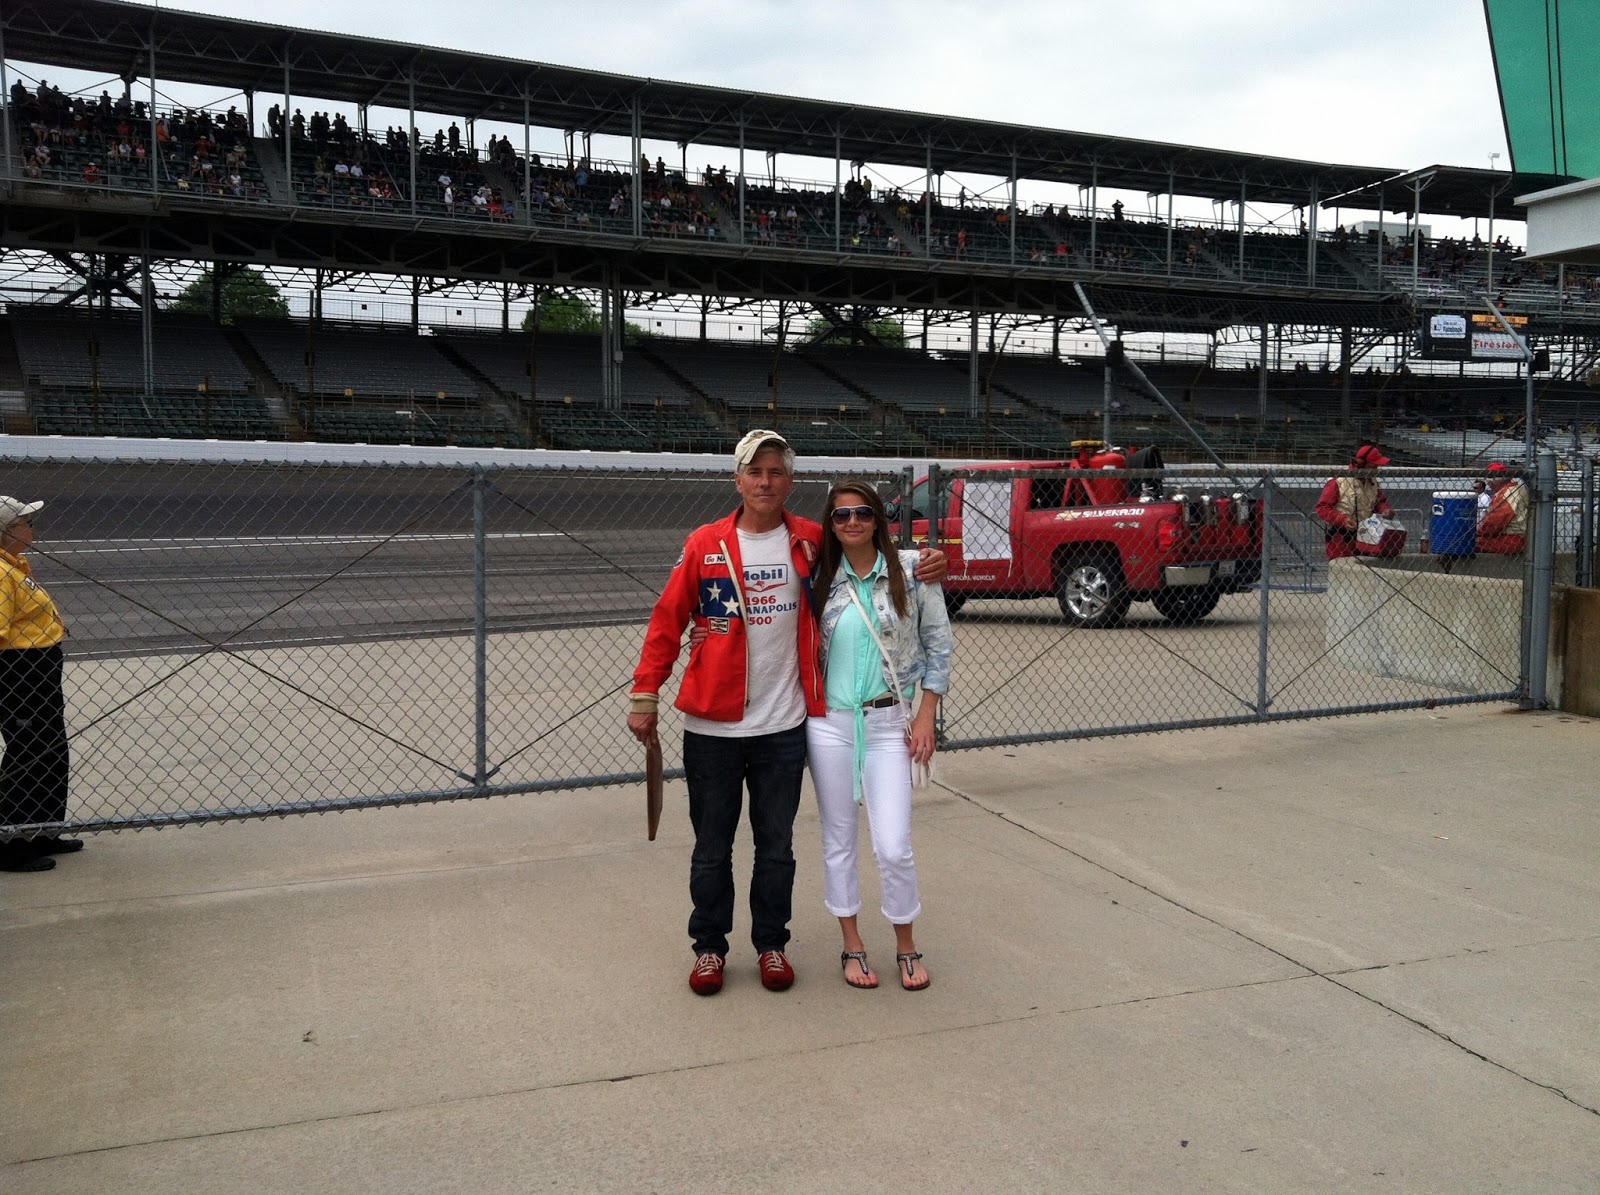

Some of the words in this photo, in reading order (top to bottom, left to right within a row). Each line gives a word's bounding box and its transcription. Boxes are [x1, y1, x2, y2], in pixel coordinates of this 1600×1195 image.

[1473, 339, 1521, 350] Fireston
[1082, 508, 1145, 518] SILVERADO
[747, 595, 777, 606] 1966
